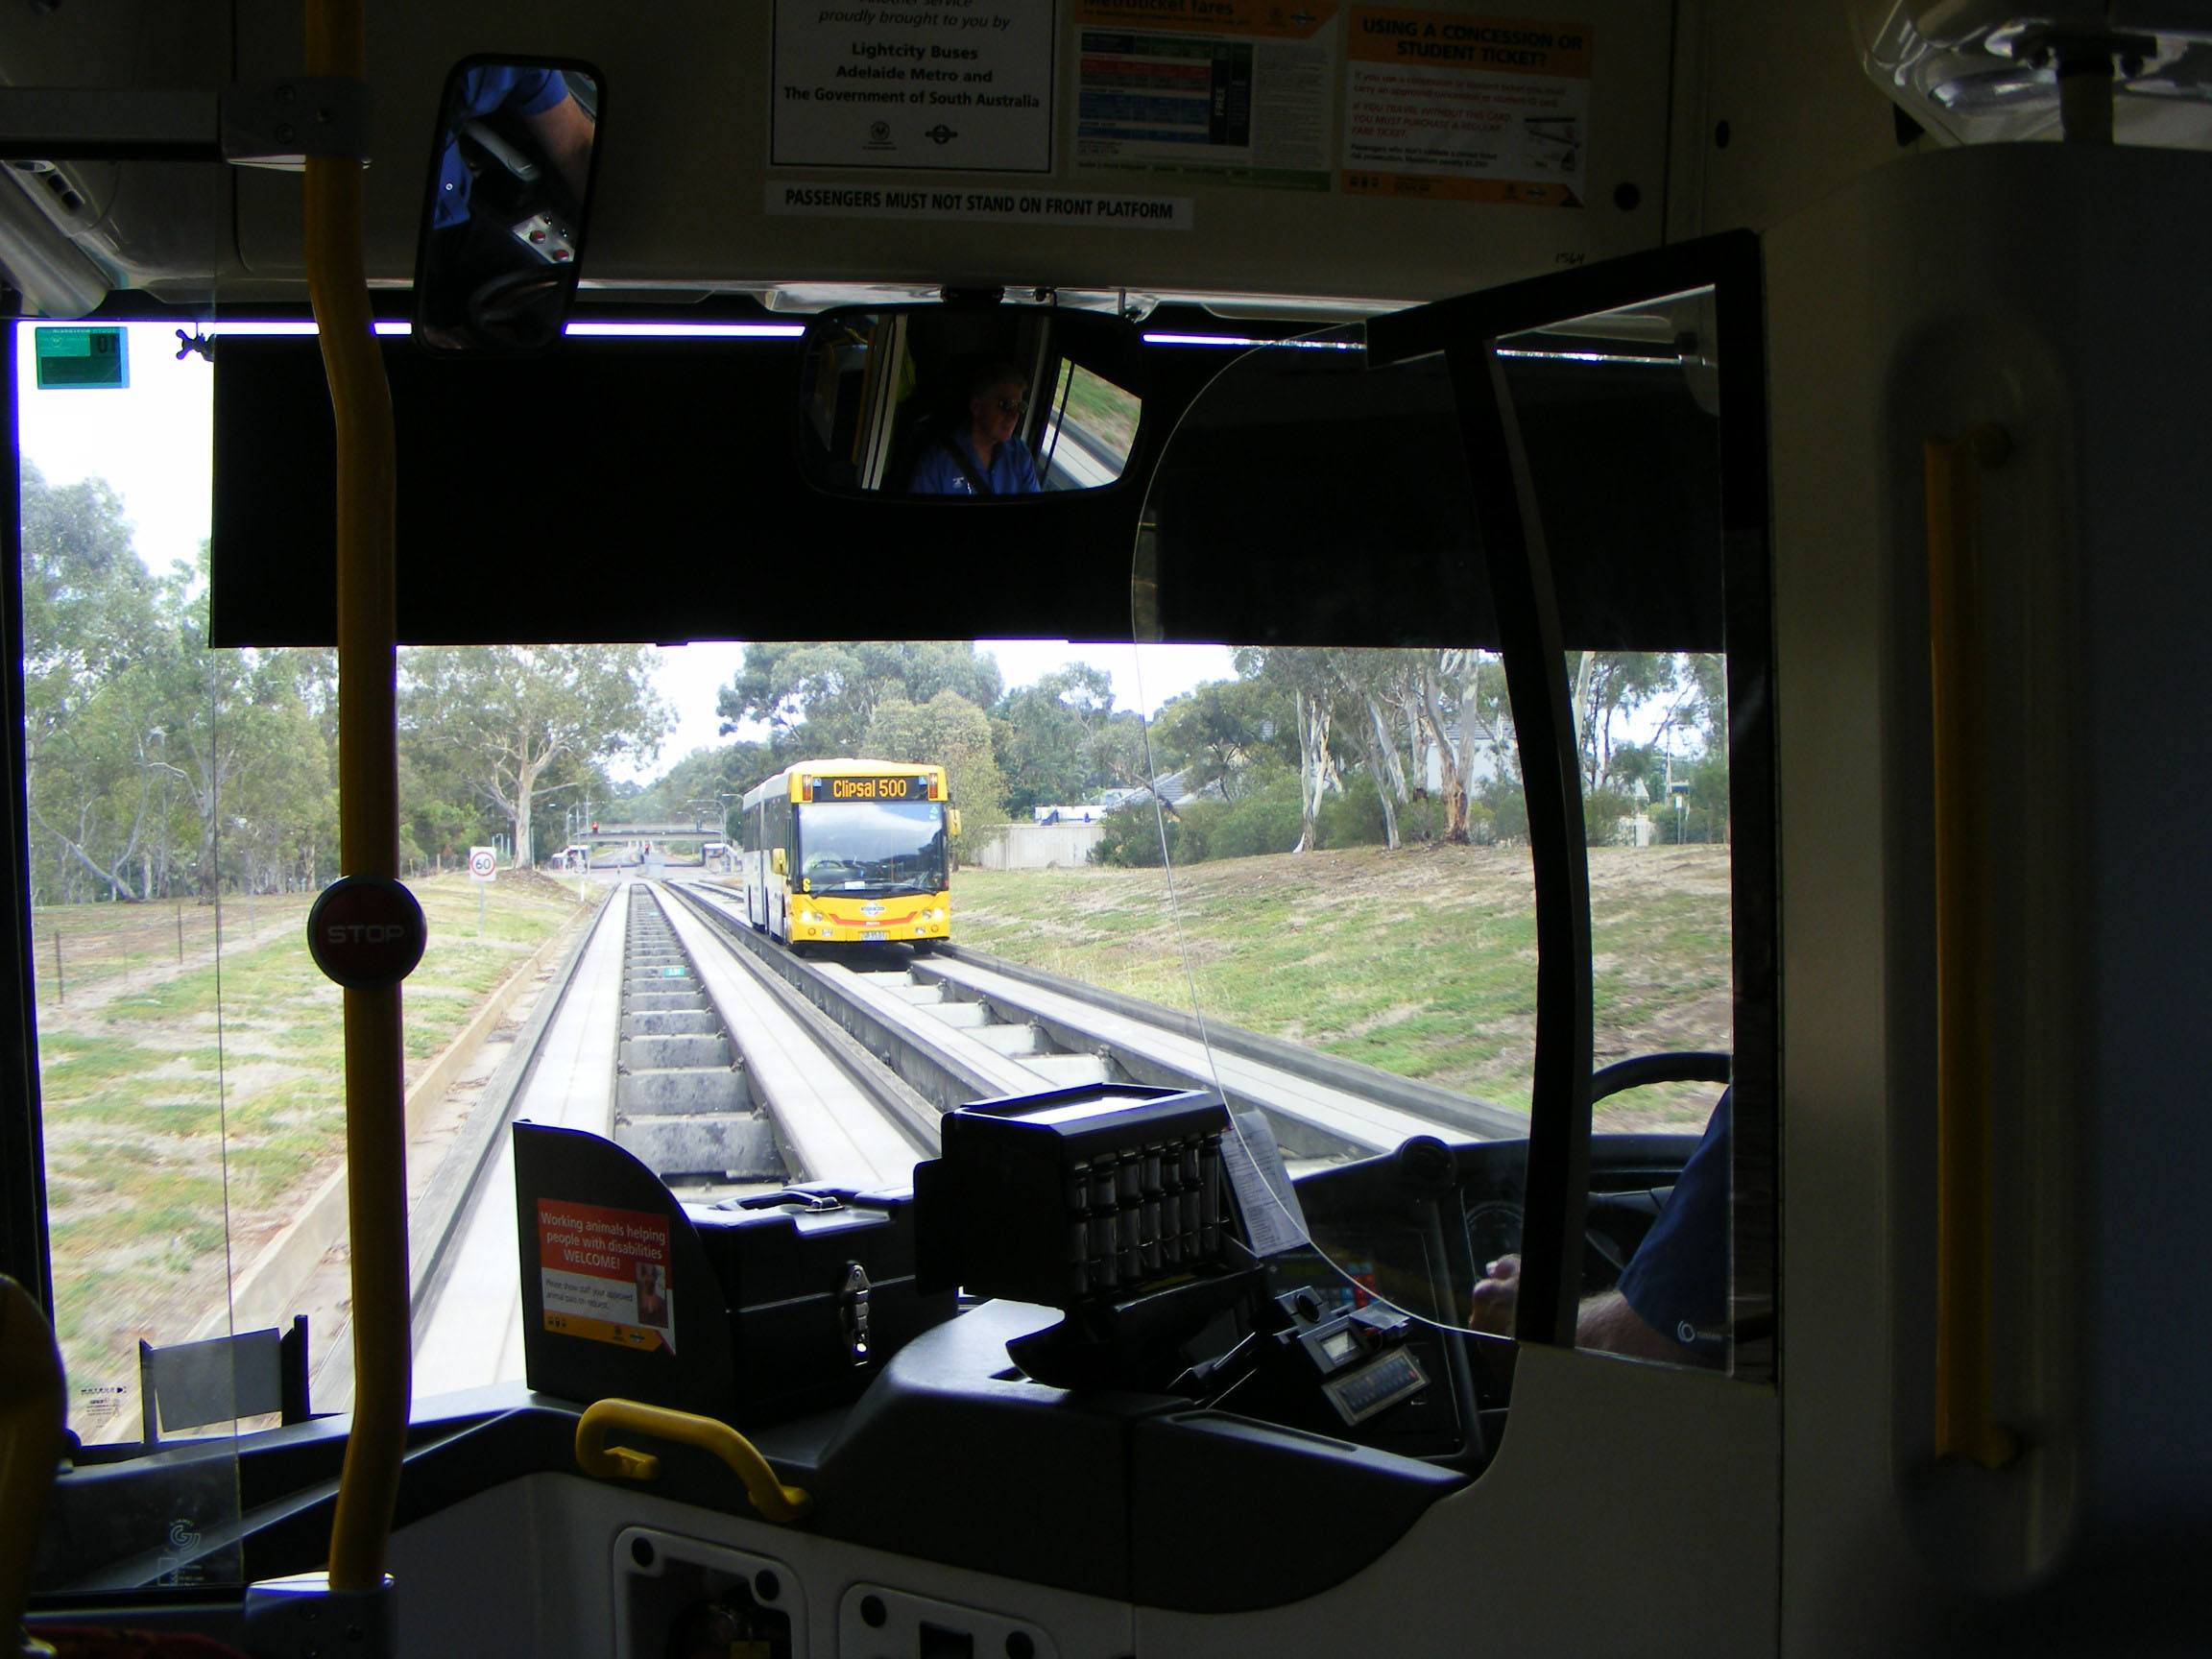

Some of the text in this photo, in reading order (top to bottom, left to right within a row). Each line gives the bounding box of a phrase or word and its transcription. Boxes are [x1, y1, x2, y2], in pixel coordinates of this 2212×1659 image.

[818, 10, 1011, 31] proudly brought to you by
[1362, 18, 1583, 51] USING A CONCESSION OR
[852, 42, 978, 60] Lightcity Buses
[1397, 41, 1548, 67] STUDENT TICKET?
[836, 65, 994, 83] Adelaide Metro and
[784, 86, 1040, 108] The Government of South Australia
[785, 188, 1173, 219] PASSENGERS MUST NOT STAND ON FRONT PLATFORM
[832, 779, 907, 799] Clipsal 500
[475, 858, 491, 870] 60
[803, 878, 811, 893] S
[327, 924, 404, 944] STOP
[541, 1211, 666, 1245] Working animals helping
[546, 1231, 662, 1260] people with disabilities
[564, 1249, 621, 1270] WELCOME!
